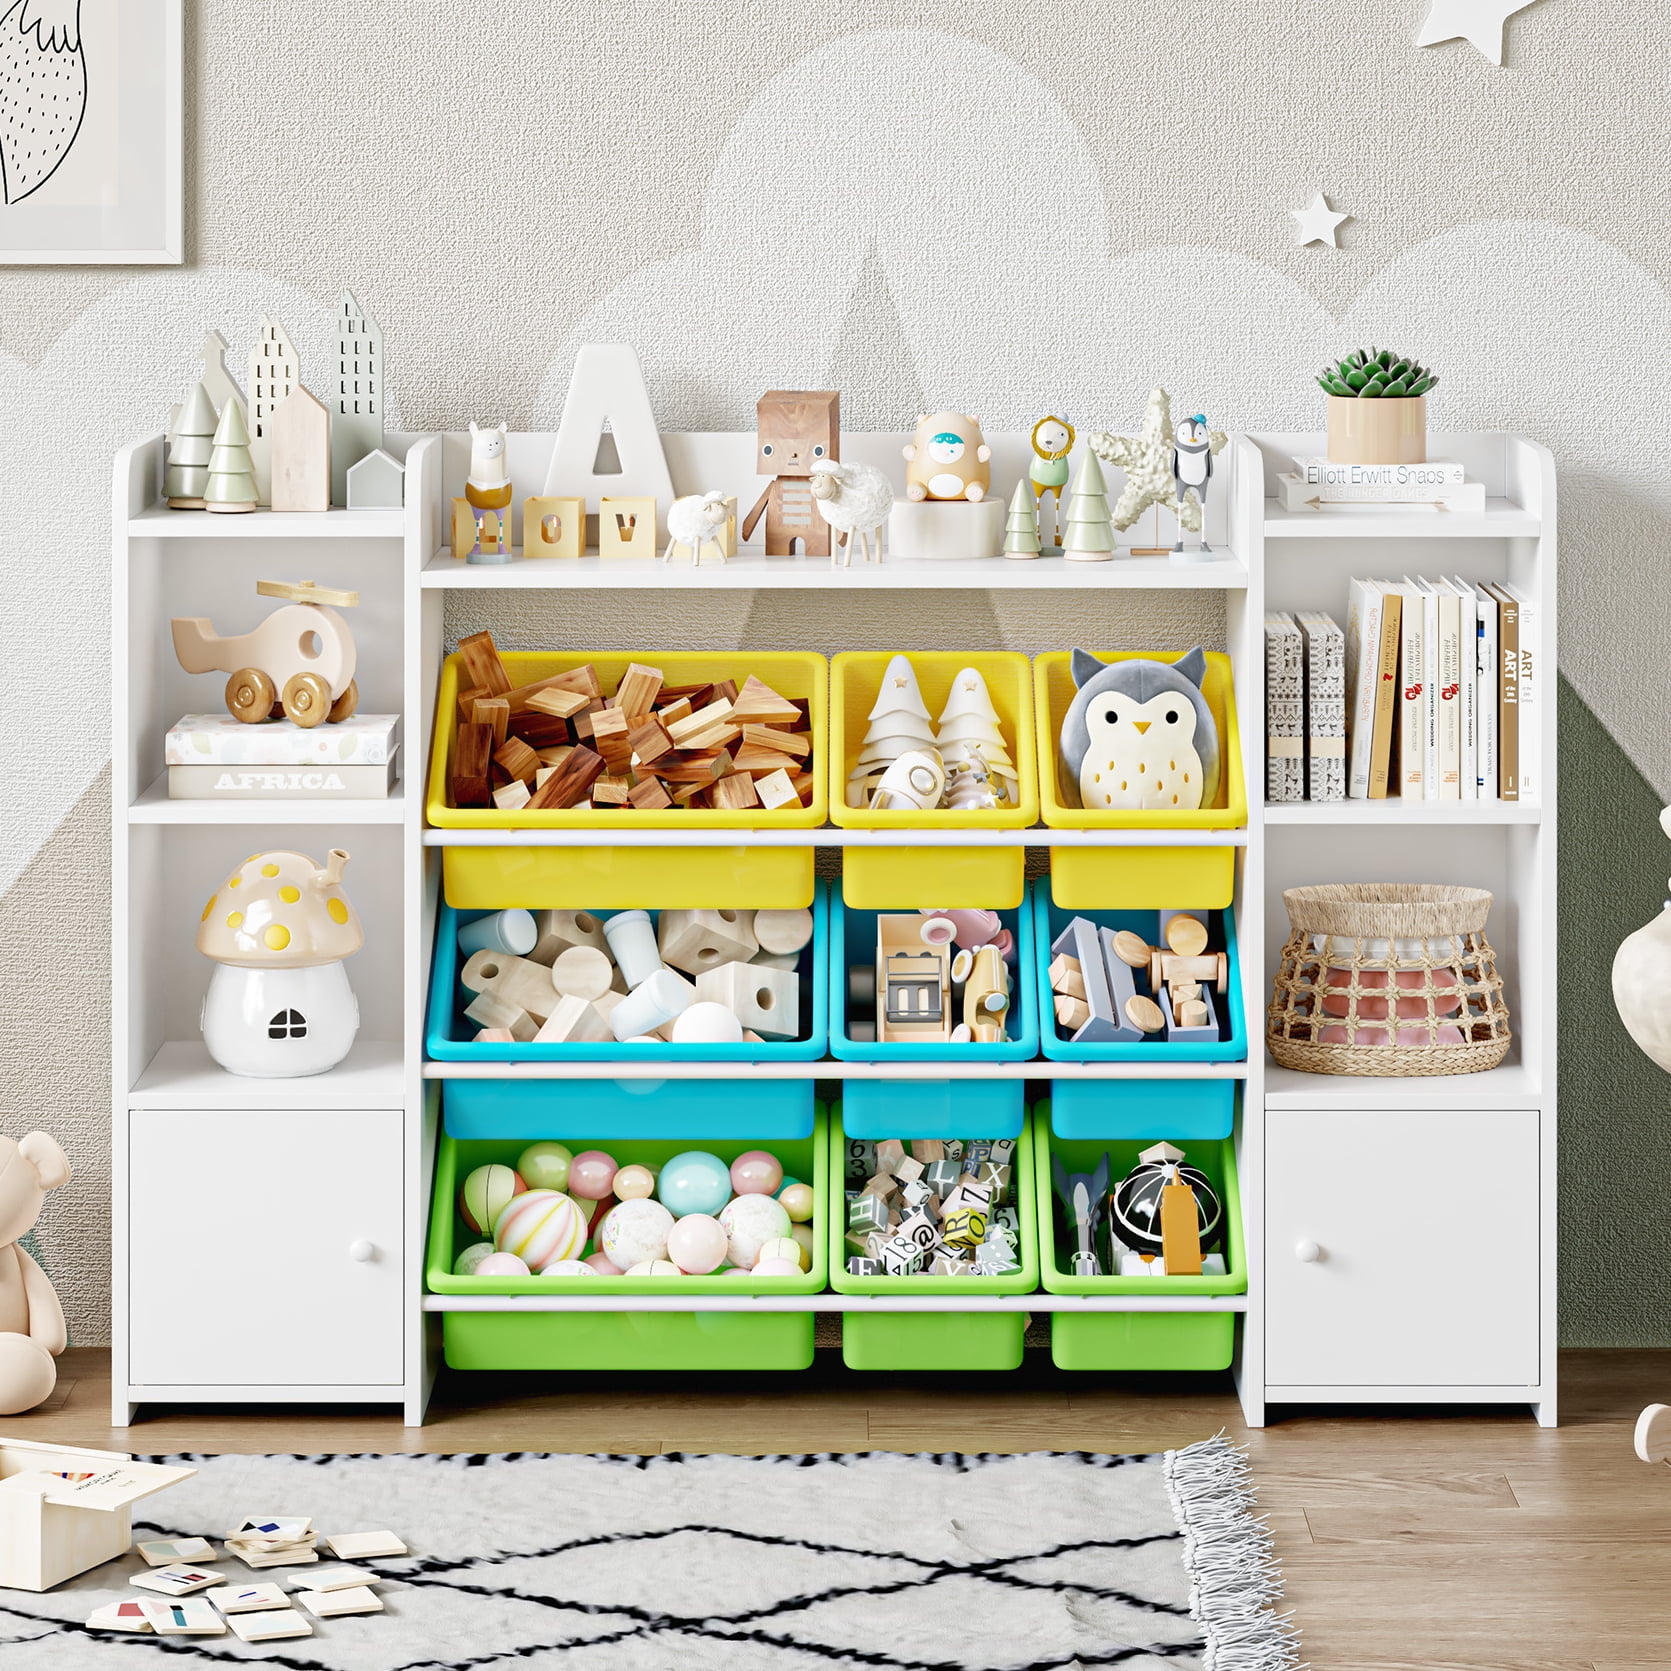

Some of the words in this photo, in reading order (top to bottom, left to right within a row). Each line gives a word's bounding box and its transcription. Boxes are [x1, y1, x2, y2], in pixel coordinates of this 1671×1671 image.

[1307, 466, 1346, 485] Elliott
[1351, 466, 1392, 485] Erwitt
[1504, 649, 1517, 682] ART
[1521, 649, 1533, 681] ART
[213, 773, 346, 791] AFRICA
[850, 1158, 867, 1177] 3
[932, 1159, 954, 1184] L
[981, 1162, 1009, 1188] X
[850, 1199, 874, 1224] H
[945, 1211, 970, 1236] R
[912, 1224, 936, 1252] @
[969, 1215, 986, 1239] O
[886, 1237, 918, 1261] 18
